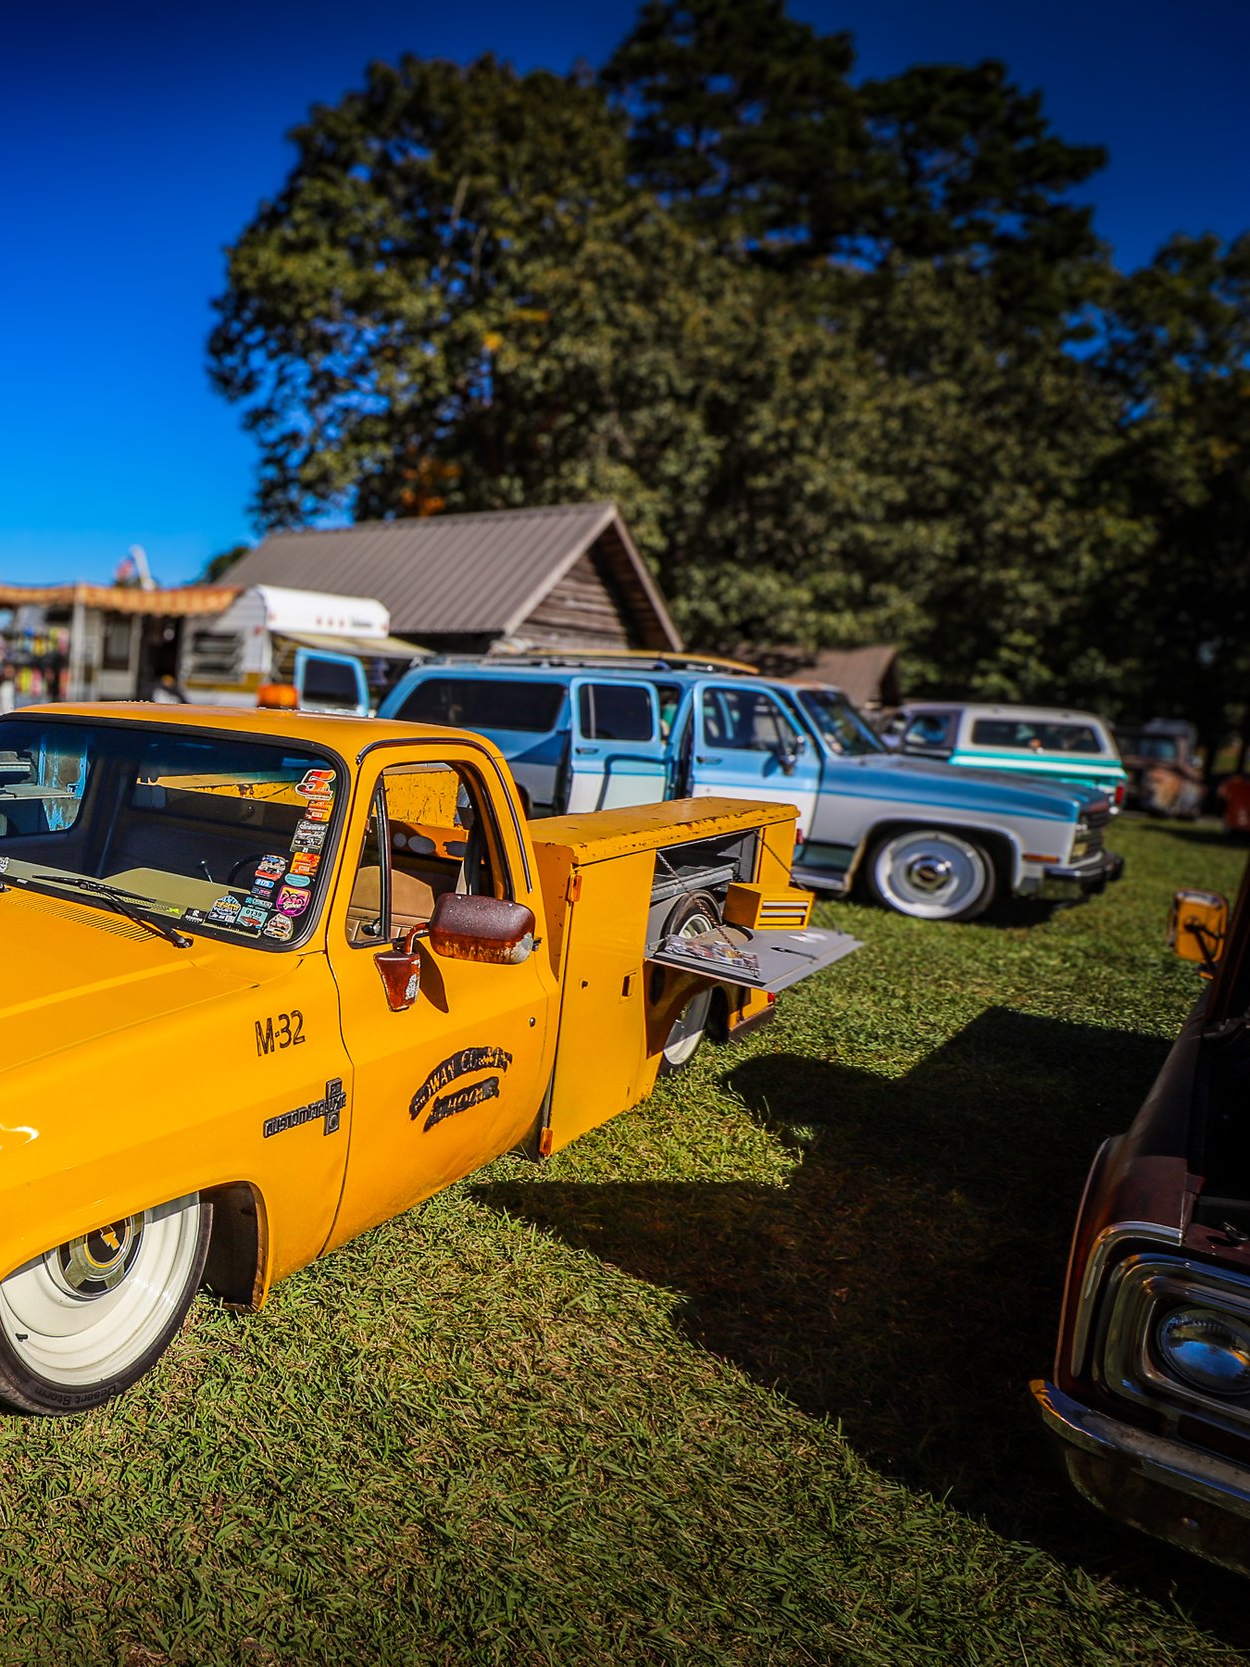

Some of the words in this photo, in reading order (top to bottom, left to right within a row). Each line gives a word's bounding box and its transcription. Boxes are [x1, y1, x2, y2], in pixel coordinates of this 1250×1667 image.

[254, 1009, 306, 1057] M-32
[263, 1106, 308, 1138] CUSTOM
[34, 1386, 72, 1406] Storm
[74, 1384, 117, 1404] Desert
